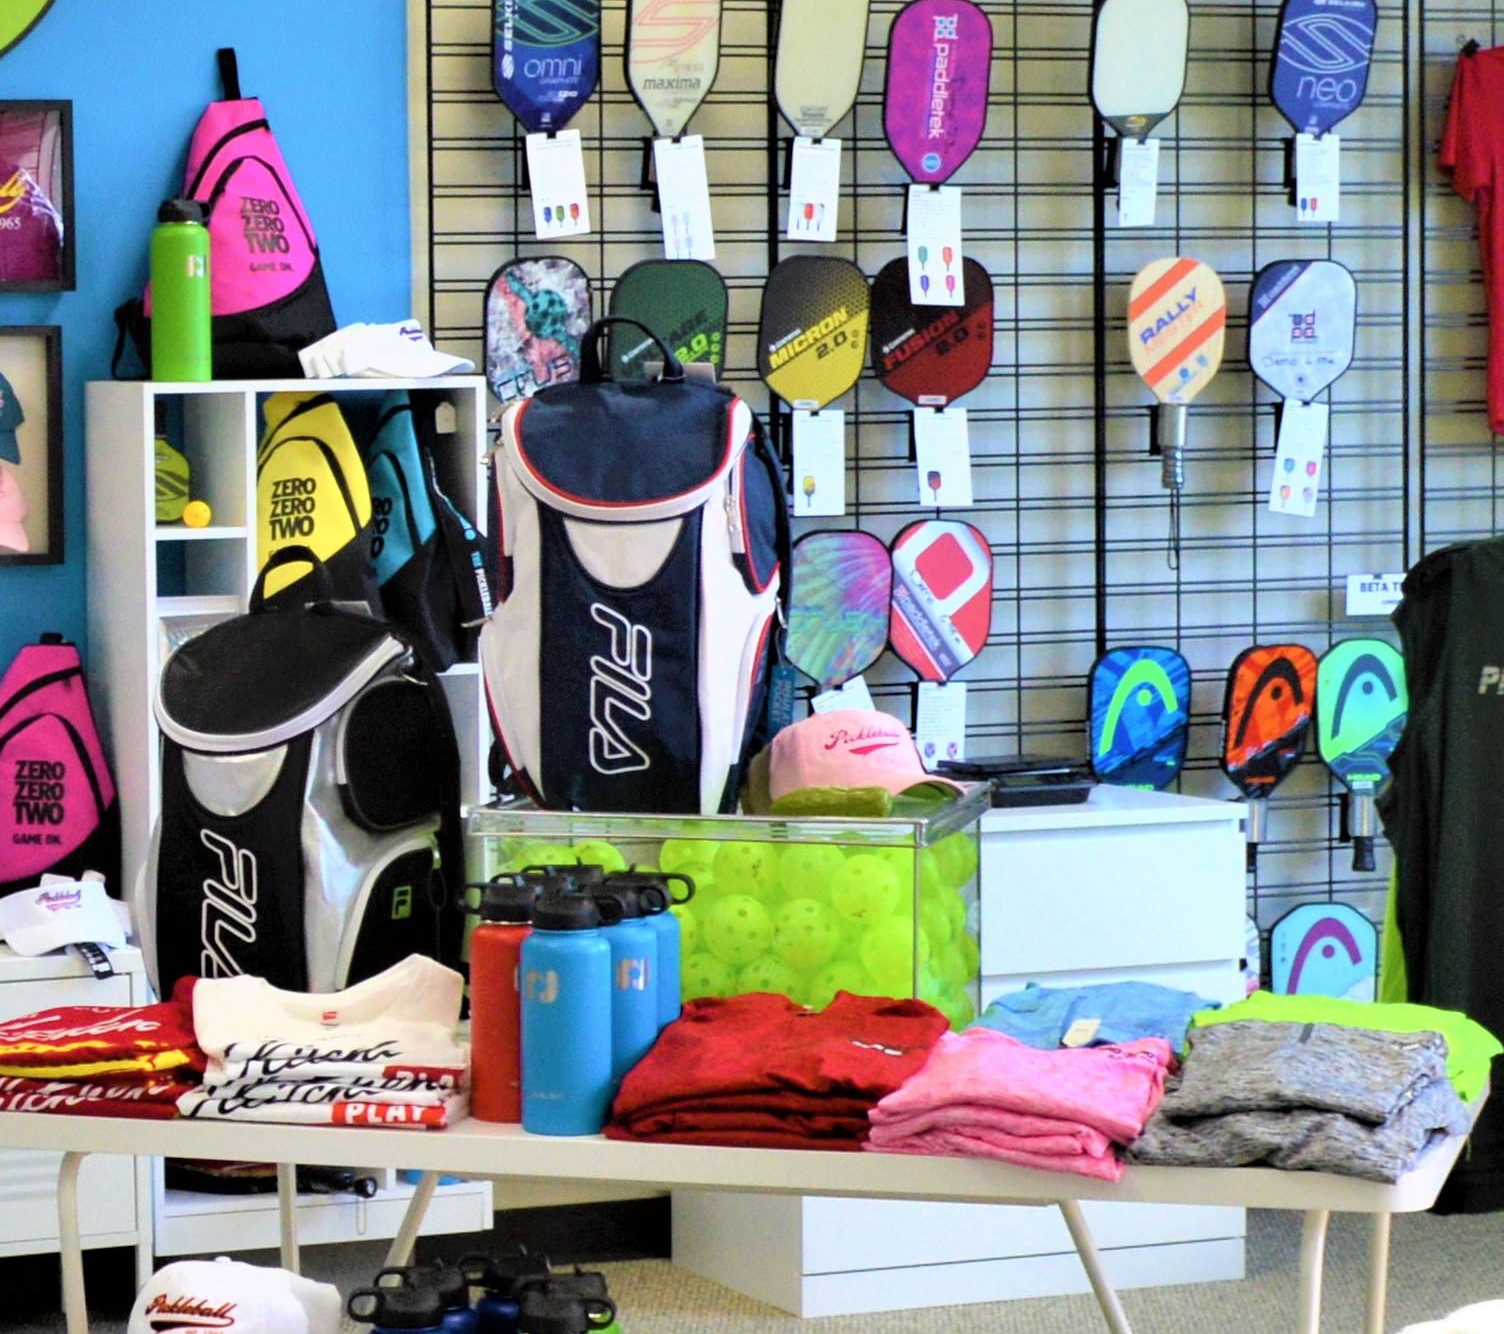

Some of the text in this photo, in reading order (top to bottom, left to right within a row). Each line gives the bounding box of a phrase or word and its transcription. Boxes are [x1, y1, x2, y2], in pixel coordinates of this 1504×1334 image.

[523, 54, 583, 78] omni
[643, 77, 701, 90] maxima
[928, 43, 950, 139] paddletek
[1296, 76, 1357, 103] neo
[240, 196, 279, 215] ZERO
[241, 215, 284, 233] ZERO
[244, 233, 290, 254] TWO
[1139, 287, 1198, 346] RALLY
[768, 307, 849, 369] MICRON
[815, 330, 848, 360] 2.0
[883, 309, 960, 371] FUSION
[272, 477, 316, 498] ZERO
[270, 496, 316, 518] ZERO
[269, 515, 315, 541] TWO
[1360, 581, 1388, 593] BETA
[589, 602, 653, 775] FILA
[16, 760, 66, 780] ZERO
[1347, 772, 1382, 782] HEAD
[15, 782, 65, 801] ZERO
[13, 803, 65, 825] TWO
[12, 833, 42, 845] GAME
[200, 828, 258, 979] FILA
[345, 1104, 426, 1124] PLAY
[145, 1293, 238, 1317] Pickleball
